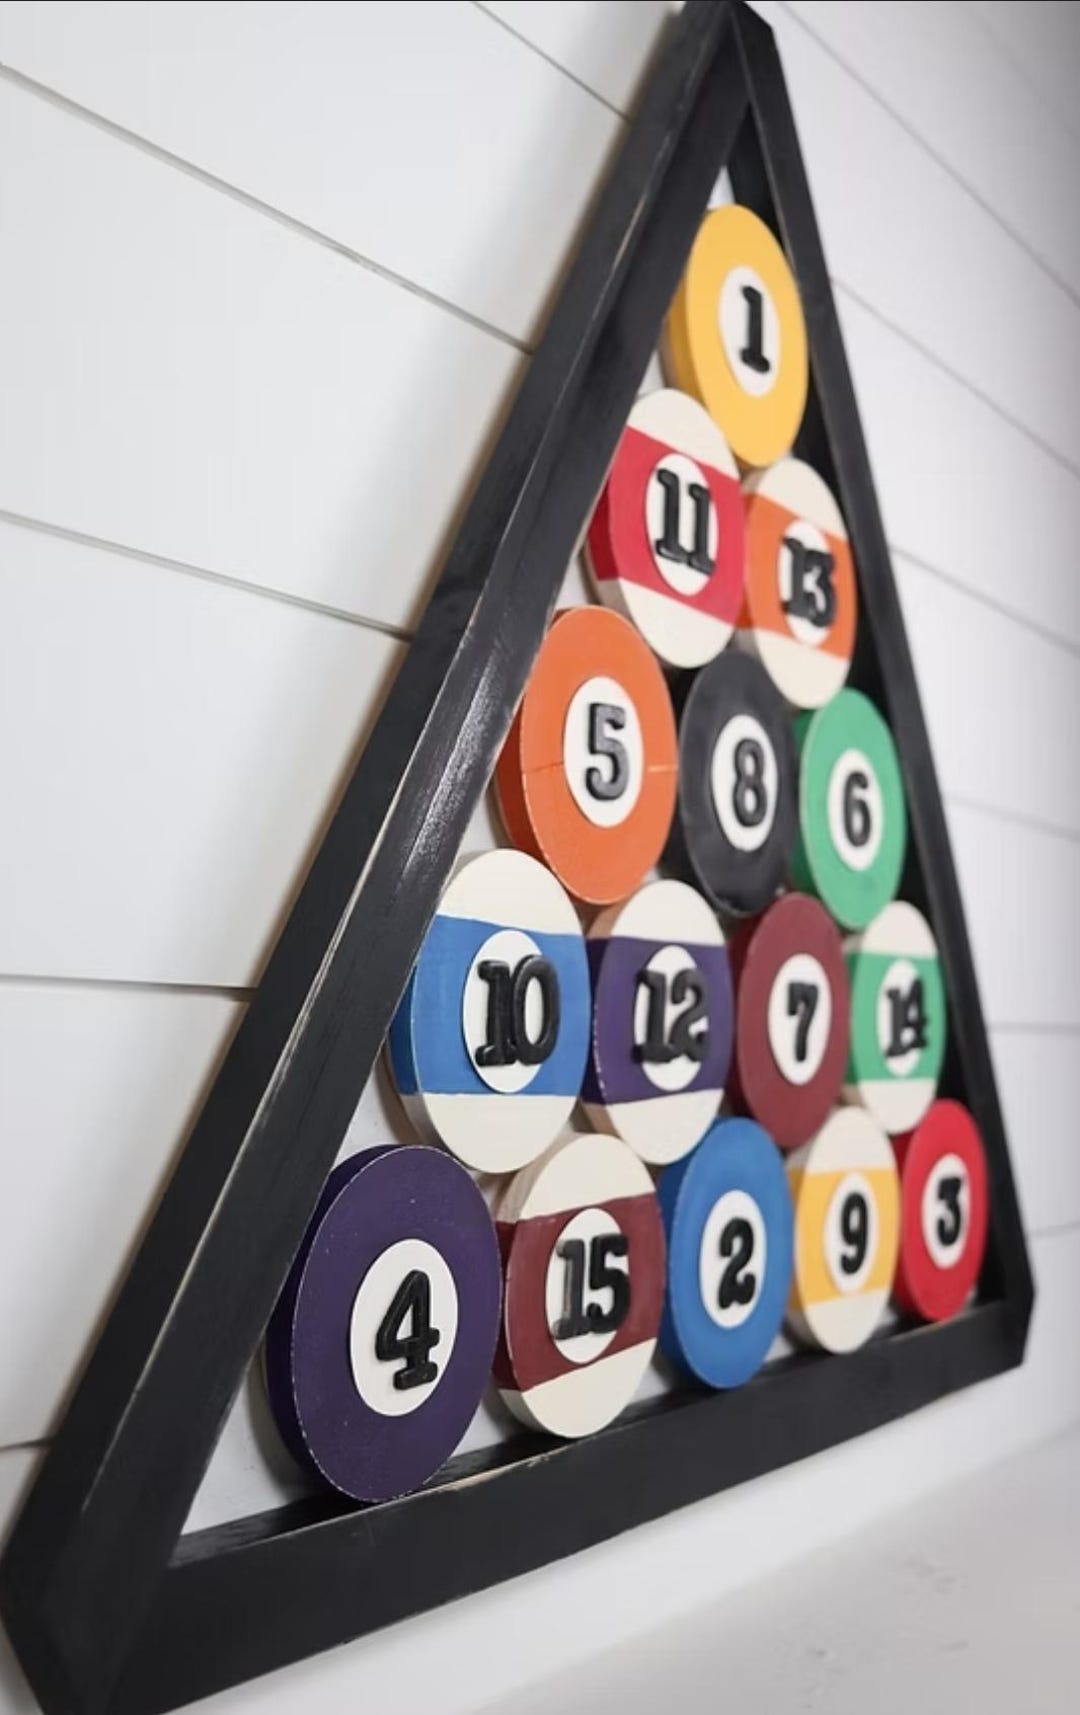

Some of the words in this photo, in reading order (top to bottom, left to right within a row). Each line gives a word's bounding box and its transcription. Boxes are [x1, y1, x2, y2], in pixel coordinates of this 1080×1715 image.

[740, 284, 771, 374] 1
[655, 467, 715, 576] 11
[782, 536, 836, 629] 13
[585, 702, 630, 802] 5
[731, 737, 770, 828] 8
[842, 770, 872, 848] 6
[474, 954, 560, 1068] 10
[632, 967, 710, 1064] 12
[786, 981, 819, 1063] 7
[884, 977, 929, 1059] 14
[839, 1191, 870, 1275] 9
[935, 1176, 963, 1247] 3
[552, 1231, 632, 1341] 15
[717, 1215, 758, 1311] 2
[374, 1269, 440, 1391] 4
